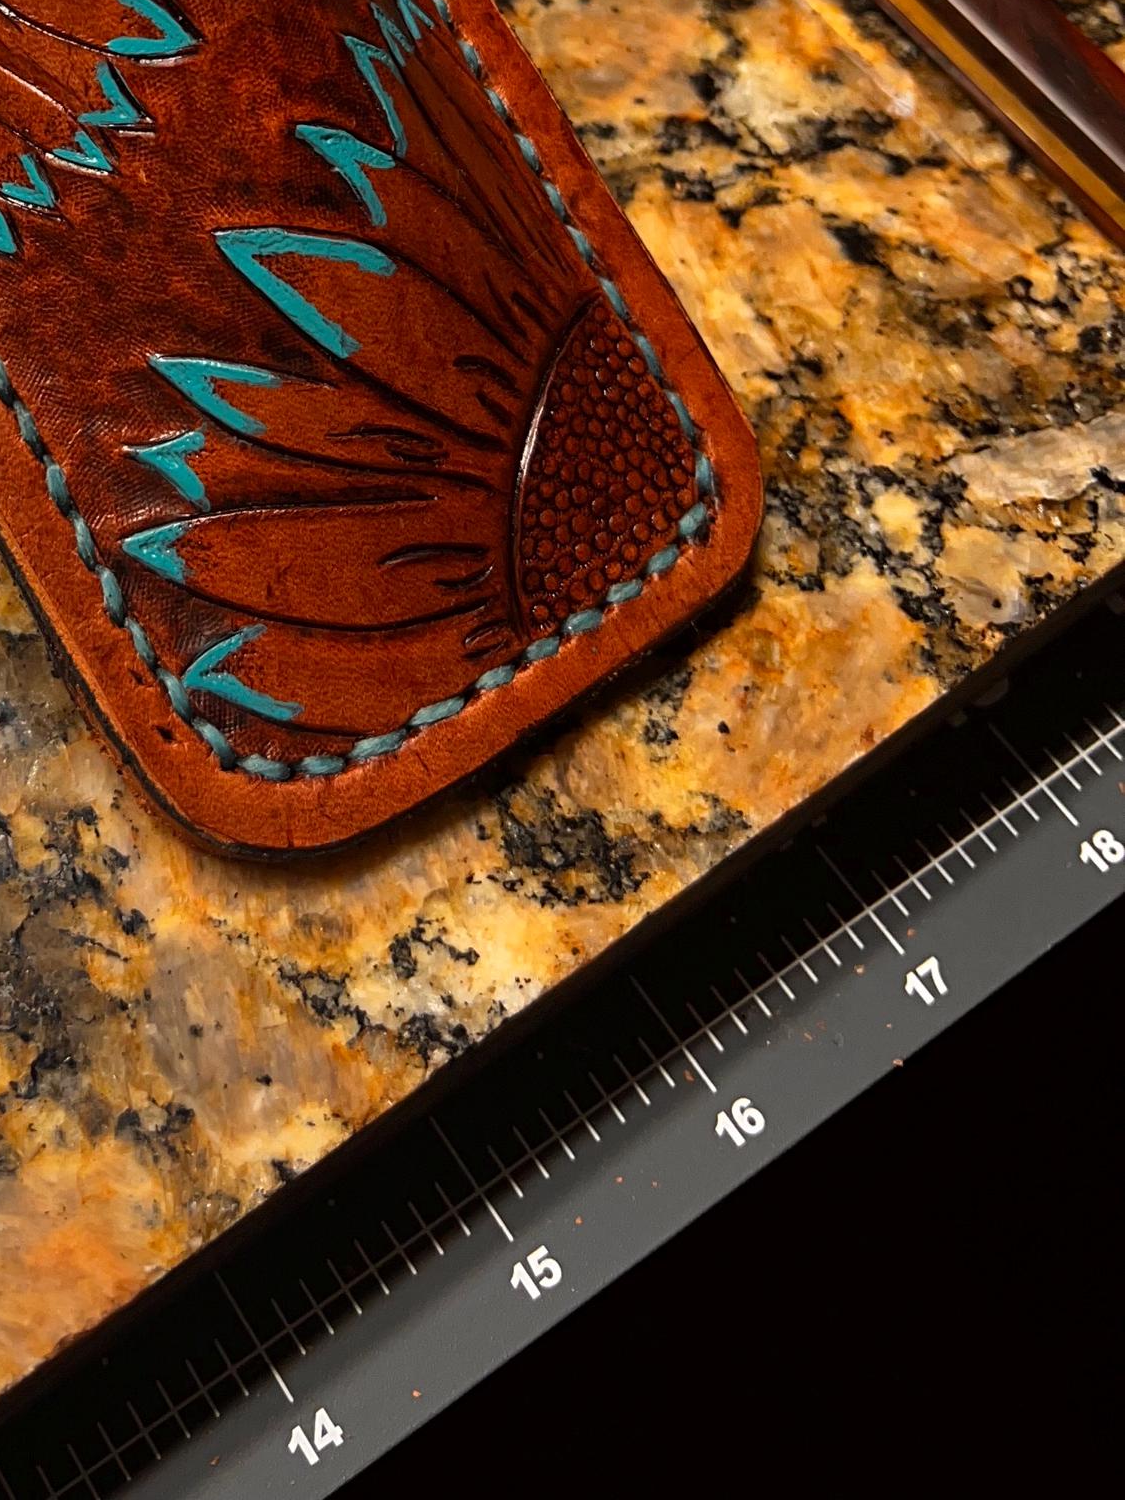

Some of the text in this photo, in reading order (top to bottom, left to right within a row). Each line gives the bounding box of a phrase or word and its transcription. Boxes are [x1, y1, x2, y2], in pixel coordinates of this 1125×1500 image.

[1079, 829, 1125, 873] 18
[903, 955, 949, 1006] 17
[714, 1097, 766, 1147] 16
[510, 1244, 563, 1300] 15
[287, 1407, 344, 1466] 14
